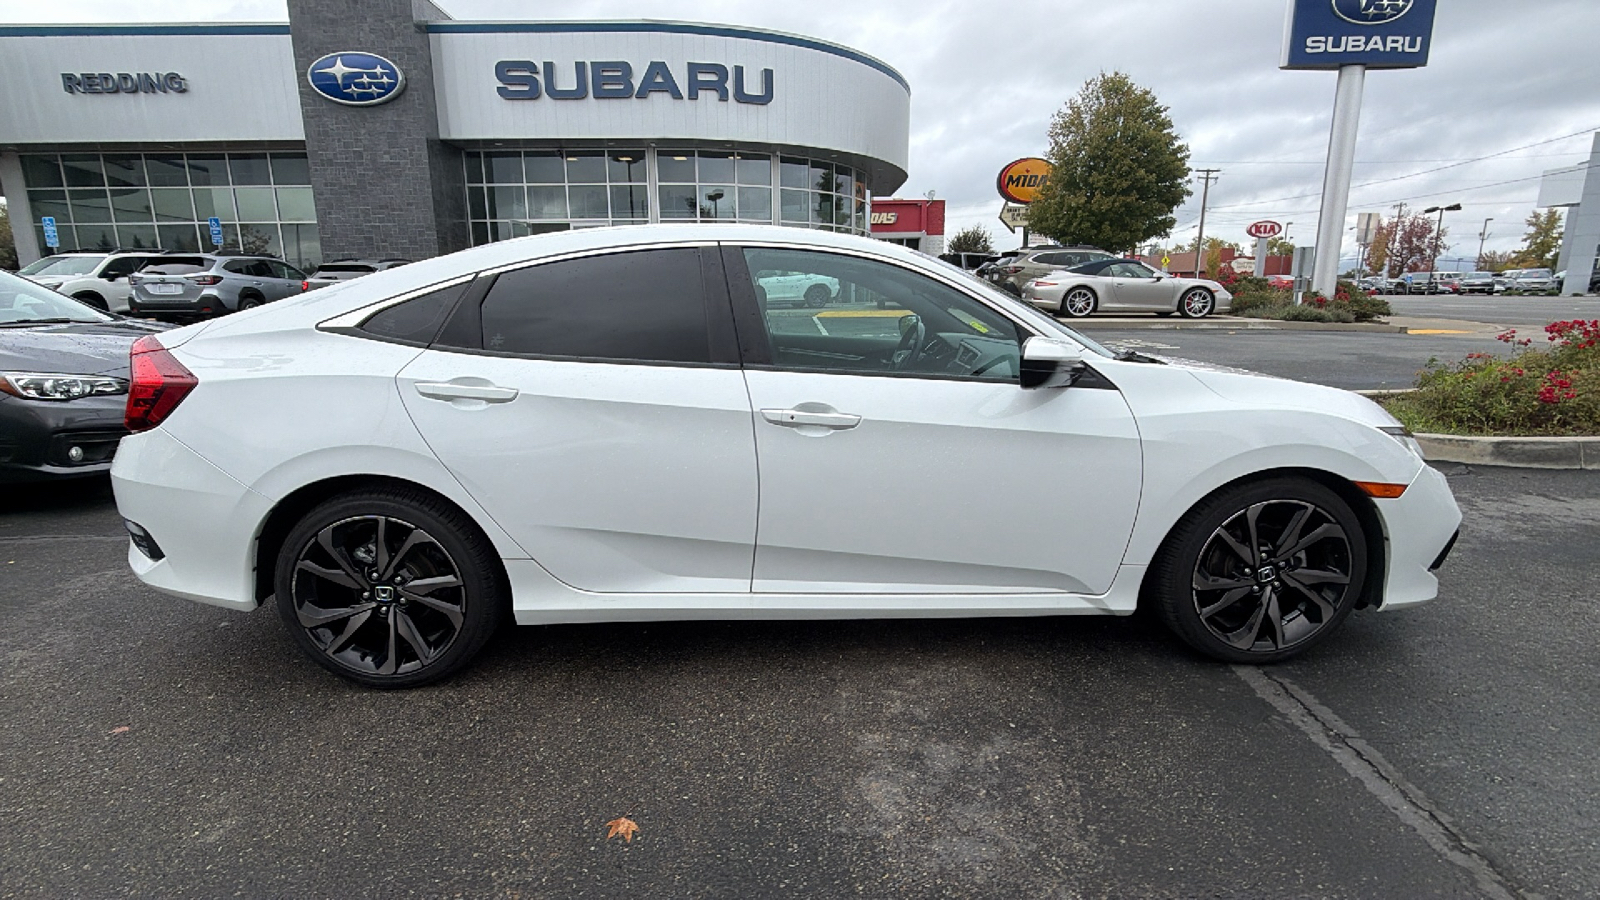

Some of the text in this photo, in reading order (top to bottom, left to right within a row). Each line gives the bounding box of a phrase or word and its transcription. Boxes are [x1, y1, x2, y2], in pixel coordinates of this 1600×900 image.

[1305, 36, 1423, 53] SUBARU
[61, 72, 188, 94] REDDING
[495, 60, 774, 105] SUBARU
[1006, 174, 1049, 188] MIDA
[870, 212, 898, 224] DAS
[1254, 225, 1276, 234] KIA
